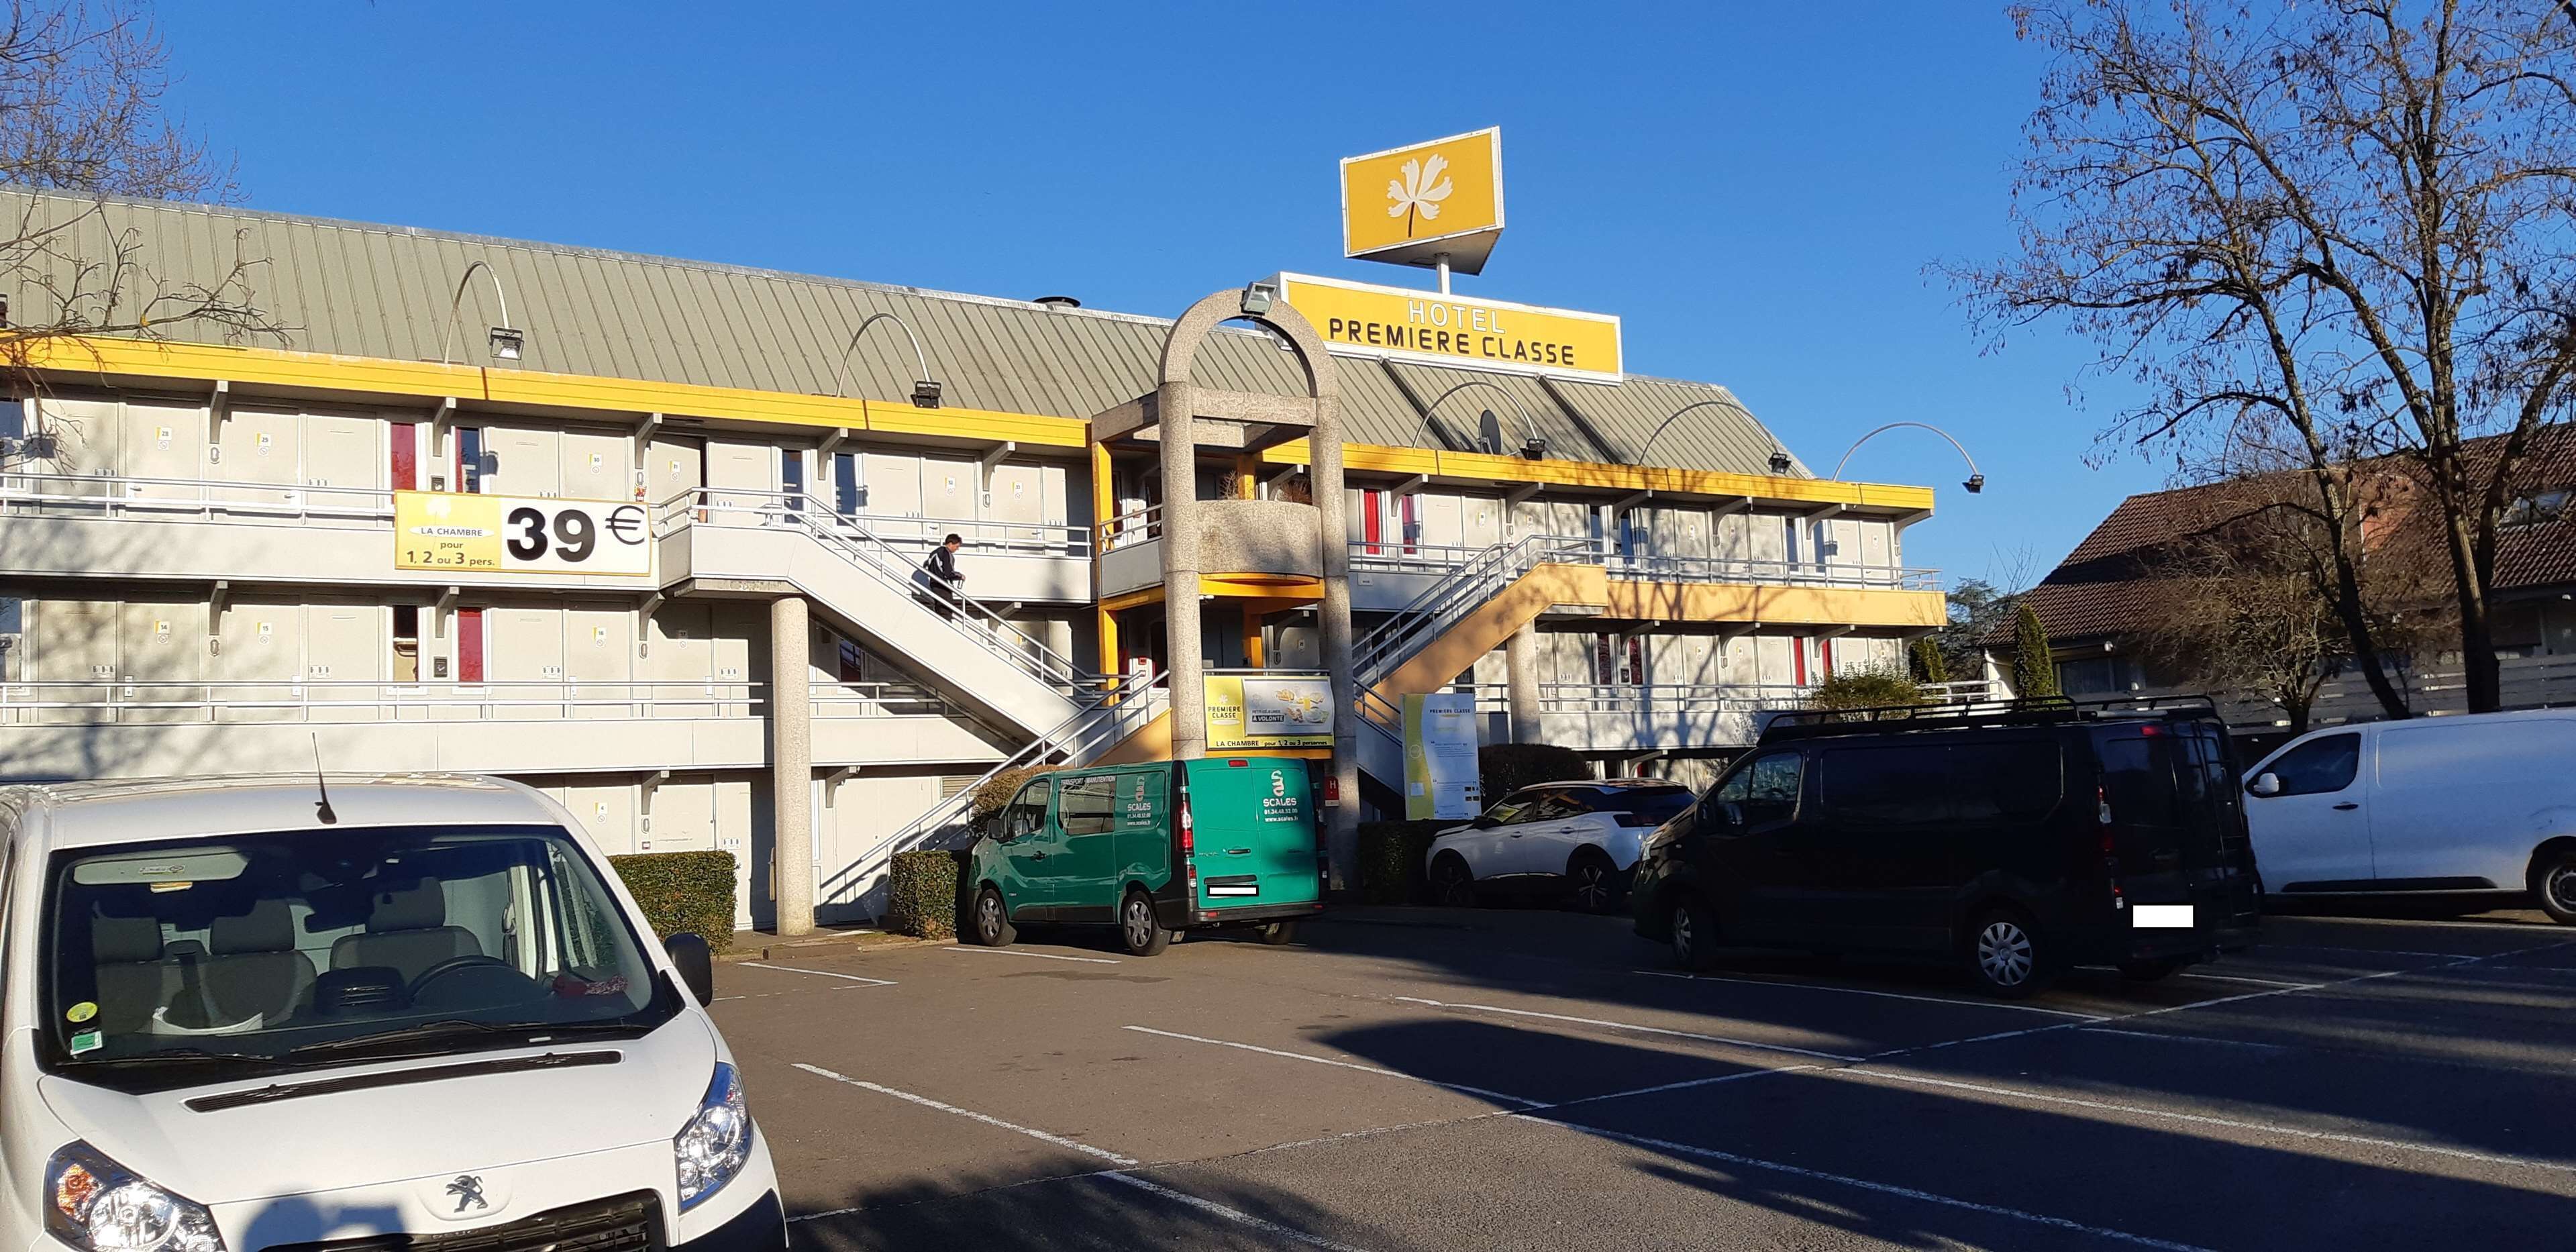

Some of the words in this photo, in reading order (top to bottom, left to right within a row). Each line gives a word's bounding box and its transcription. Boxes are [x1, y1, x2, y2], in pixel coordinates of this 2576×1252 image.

[1408, 300, 1506, 334] HOTEL
[1329, 318, 1470, 355] PREMIERE
[1482, 337, 1574, 366] CLASSE
[421, 527, 433, 535] LA
[437, 528, 483, 537] CHAMBRE
[507, 507, 595, 562] 39
[605, 505, 645, 545] €
[440, 541, 464, 550] pour
[407, 551, 417, 564] 1,
[423, 551, 433, 564] 2
[437, 556, 451, 564] ou
[455, 552, 465, 564] 3
[469, 558, 495, 568] pers.
[1330, 780, 1337, 789] H
[1127, 802, 1151, 811] SCALES
[1263, 798, 1296, 807] SCALES
